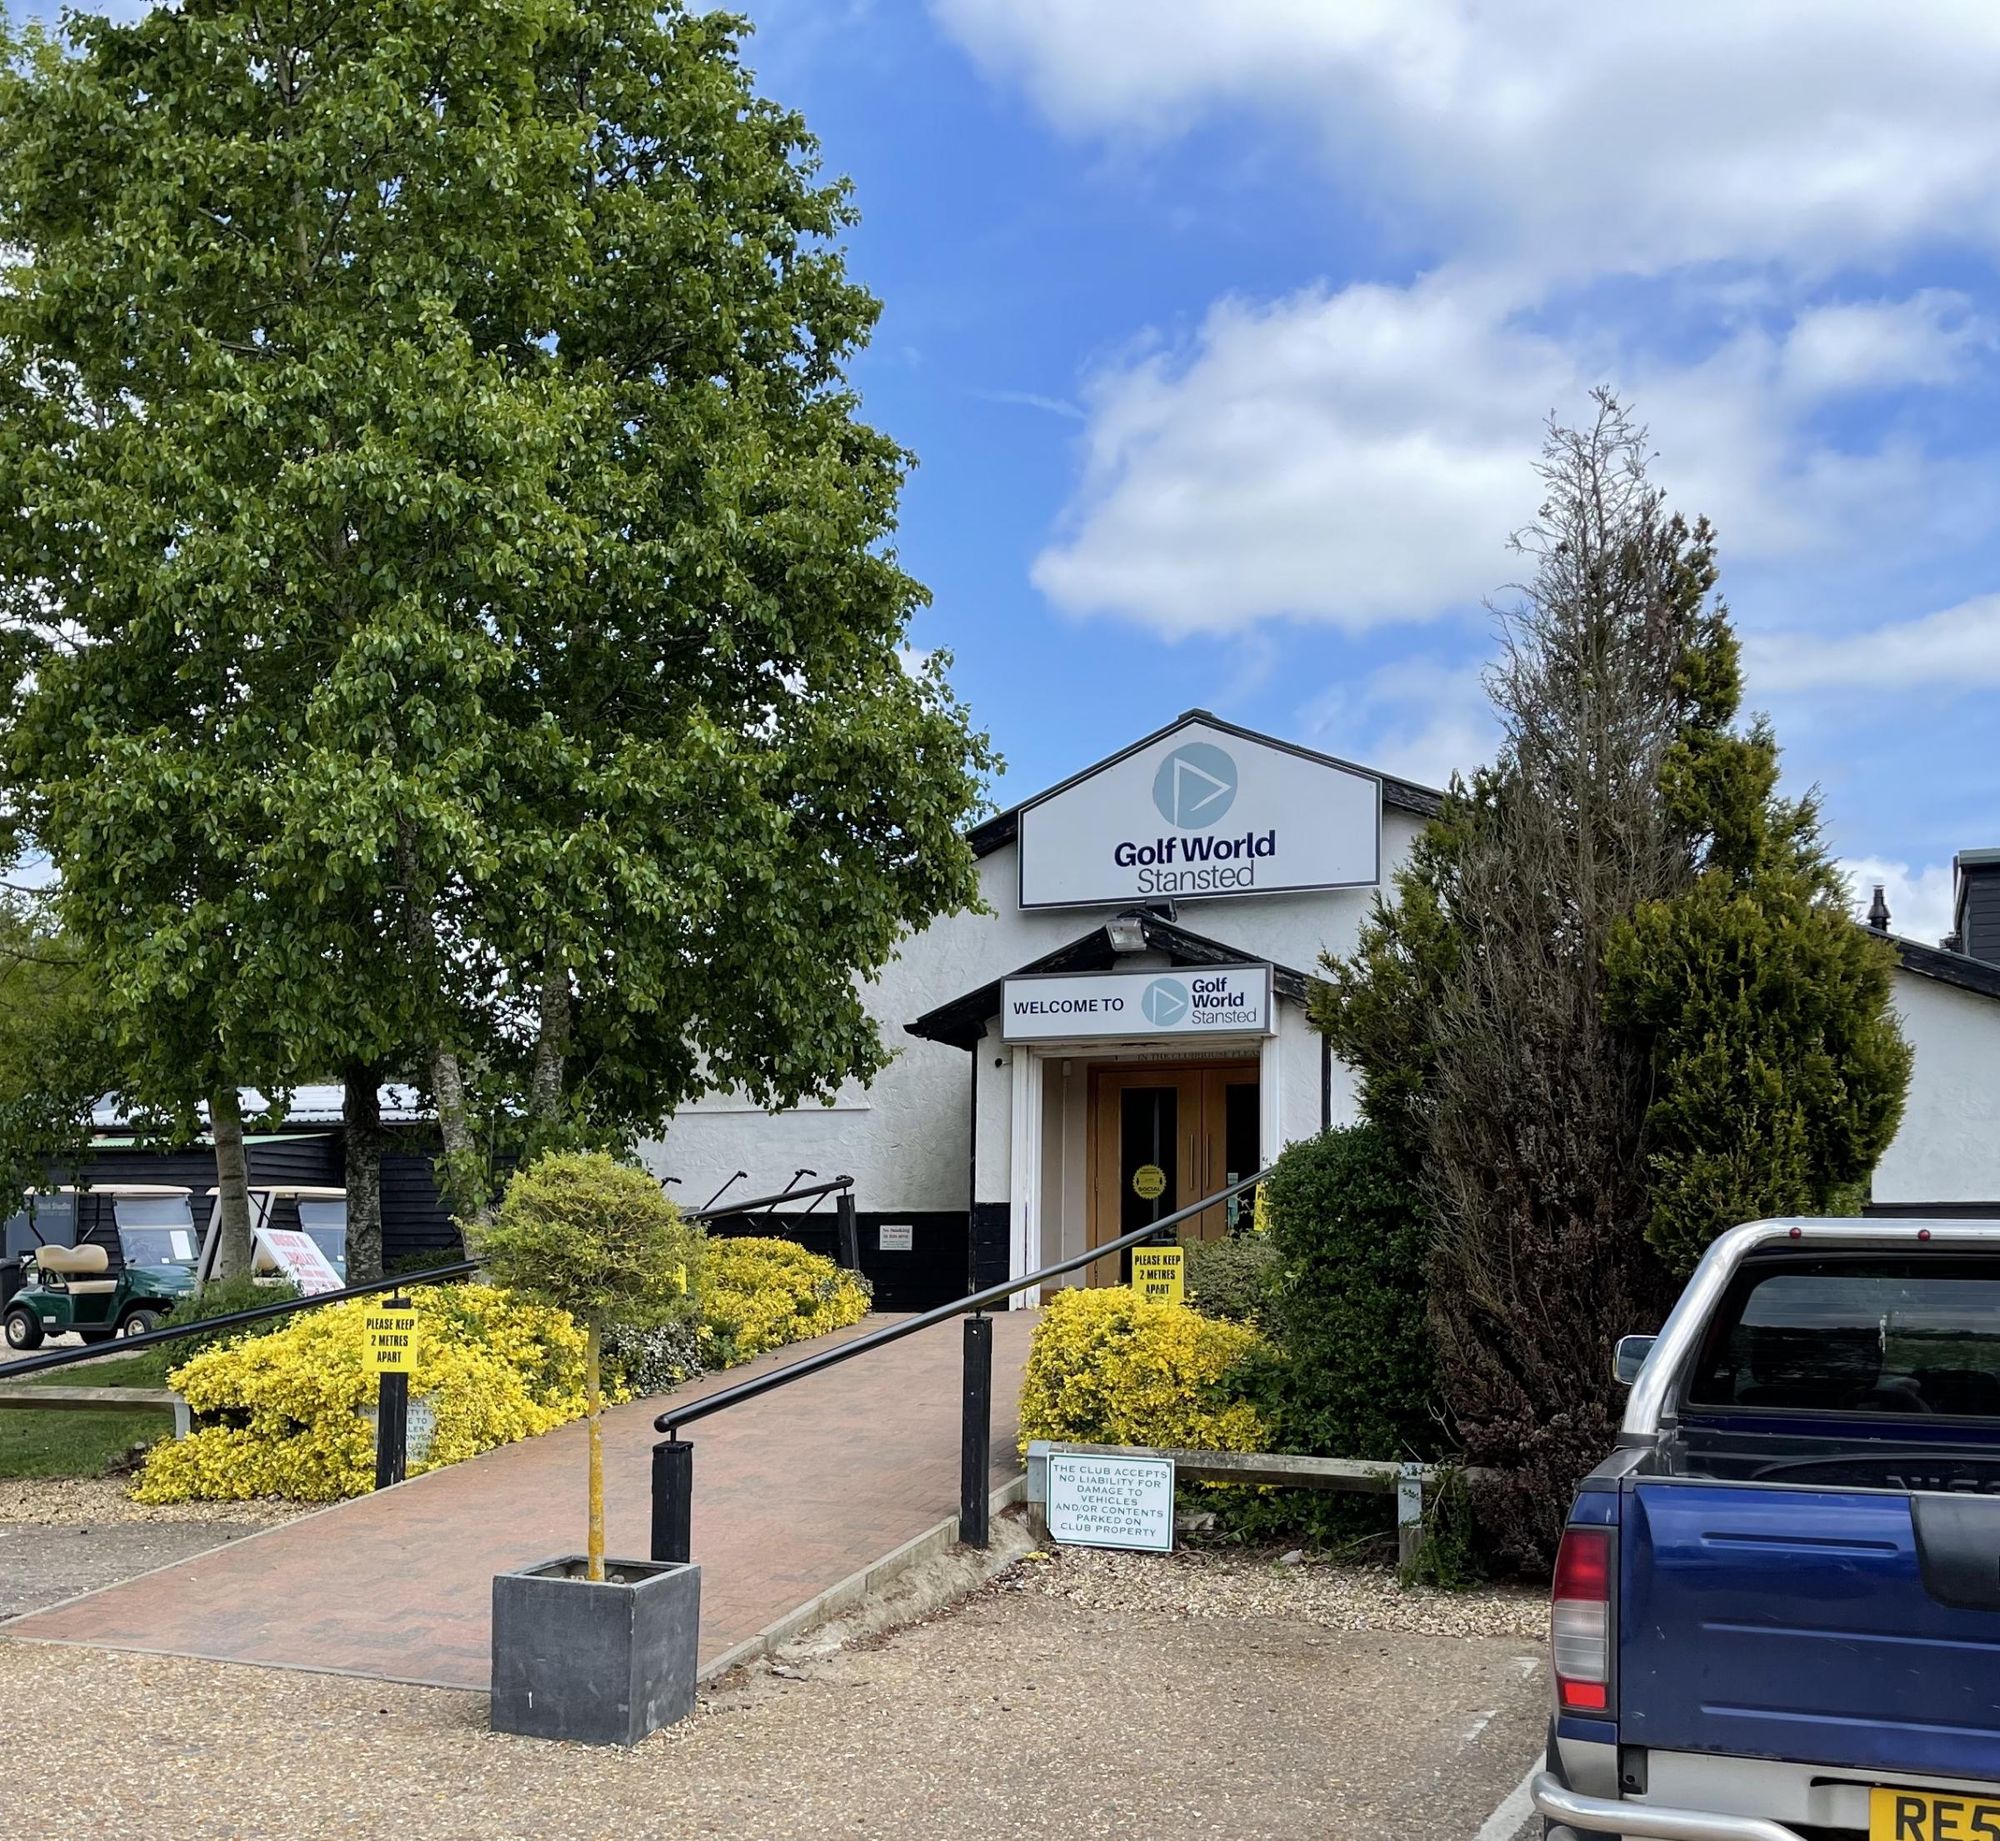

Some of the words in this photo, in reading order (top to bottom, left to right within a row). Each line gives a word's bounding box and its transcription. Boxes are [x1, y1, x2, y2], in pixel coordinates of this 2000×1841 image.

[1115, 837, 1177, 867] Golf
[1181, 830, 1275, 862] World
[1137, 860, 1254, 893] Stansted
[1192, 977, 1228, 993] Golf
[1013, 1000, 1098, 1014] WELCOME
[1102, 998, 1124, 1012] TO
[1192, 992, 1244, 1008] World
[1192, 1008, 1257, 1024] Stansted
[1135, 1255, 1160, 1265] PLEASE
[1163, 1255, 1181, 1265] KEEP
[1139, 1270, 1145, 1280] 2
[1146, 1269, 1175, 1280] METRES
[1145, 1284, 1170, 1295] APART
[366, 1318, 393, 1330] PLEASE
[395, 1319, 415, 1330] KEEP
[371, 1335, 376, 1346] 2
[378, 1335, 409, 1347] METRES
[376, 1351, 402, 1363] APART
[1054, 1464, 1076, 1473] THE
[1079, 1466, 1111, 1475] CLUB
[1114, 1468, 1168, 1479] ACCEPTS
[1059, 1474, 1076, 1483] NO
[1079, 1476, 1134, 1486] LIABILITY
[1138, 1479, 1161, 1488] FOR
[1077, 1485, 1123, 1495] DAMAGE
[1127, 1488, 1143, 1497] TO
[1080, 1495, 1138, 1506] VEHICLES
[1055, 1503, 1098, 1513] AND/OR
[1101, 1506, 1164, 1518] CONTENTS
[1076, 1513, 1122, 1525] PARKED
[1125, 1517, 1141, 1526] ON
[1060, 1522, 1092, 1532] CLUB
[1095, 1525, 1157, 1537] PROPERTY
